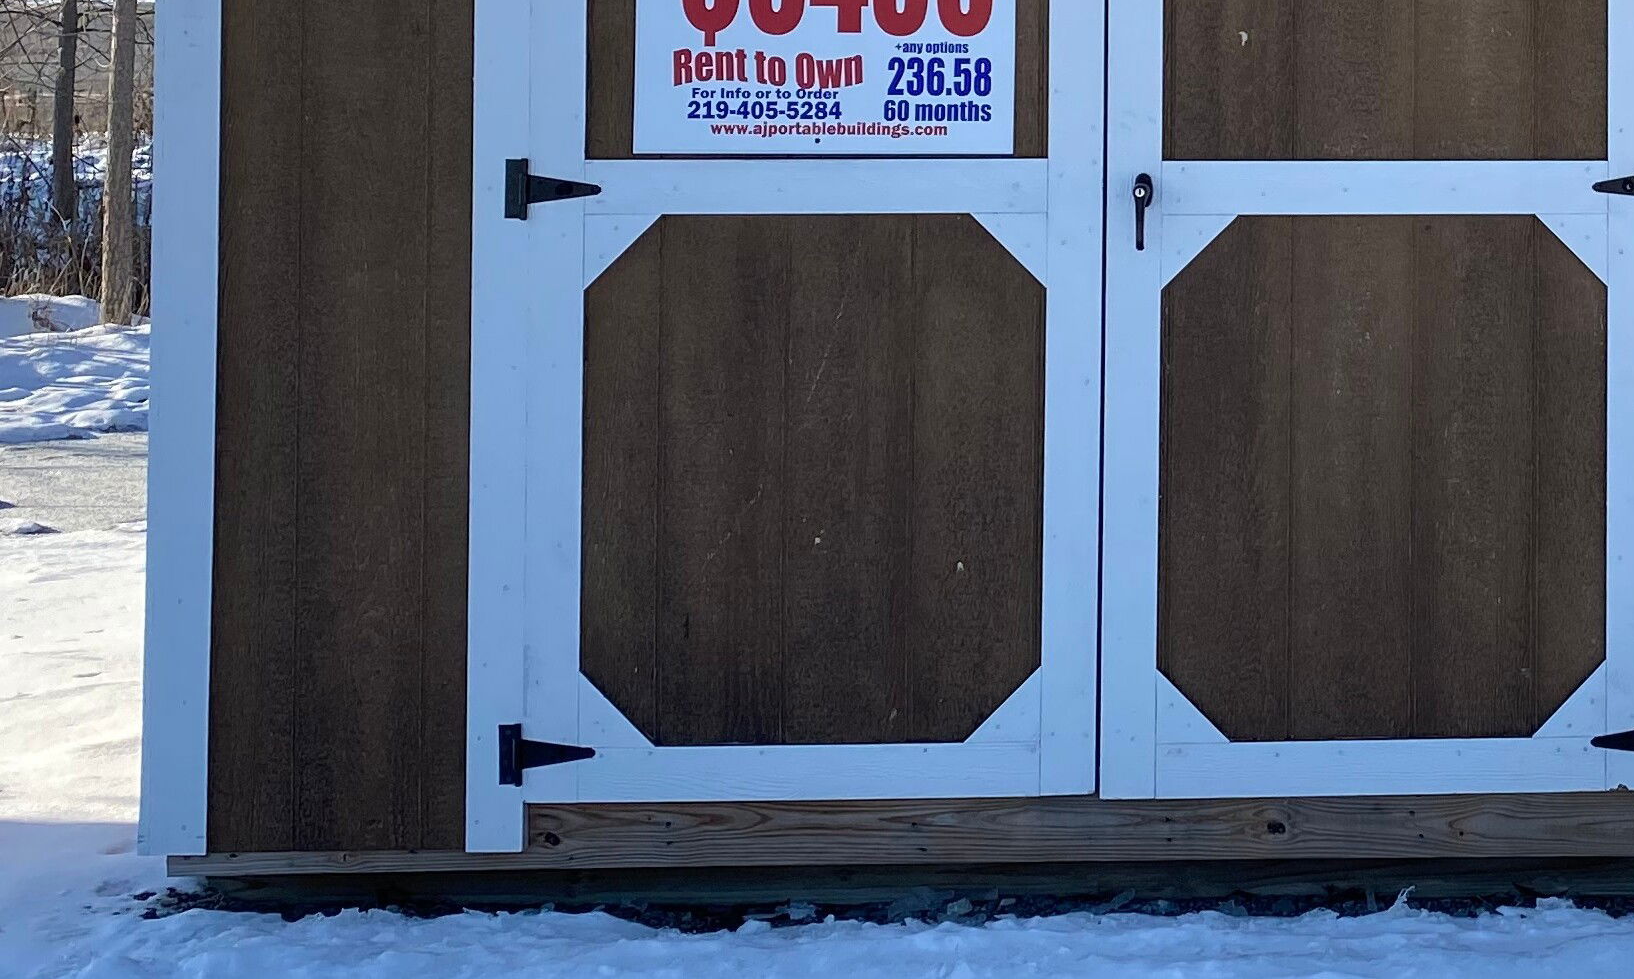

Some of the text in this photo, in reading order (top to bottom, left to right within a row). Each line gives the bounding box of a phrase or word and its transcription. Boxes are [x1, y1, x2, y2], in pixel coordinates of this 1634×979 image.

[895, 41, 969, 55] +any options
[673, 48, 864, 89] Rent to Own
[886, 57, 992, 97] 236.58
[692, 87, 839, 100] For Info or to Order
[687, 100, 842, 120] 219-405-5284
[883, 99, 992, 122] 60 months
[710, 121, 948, 138] www.ajportablebuildings.com
